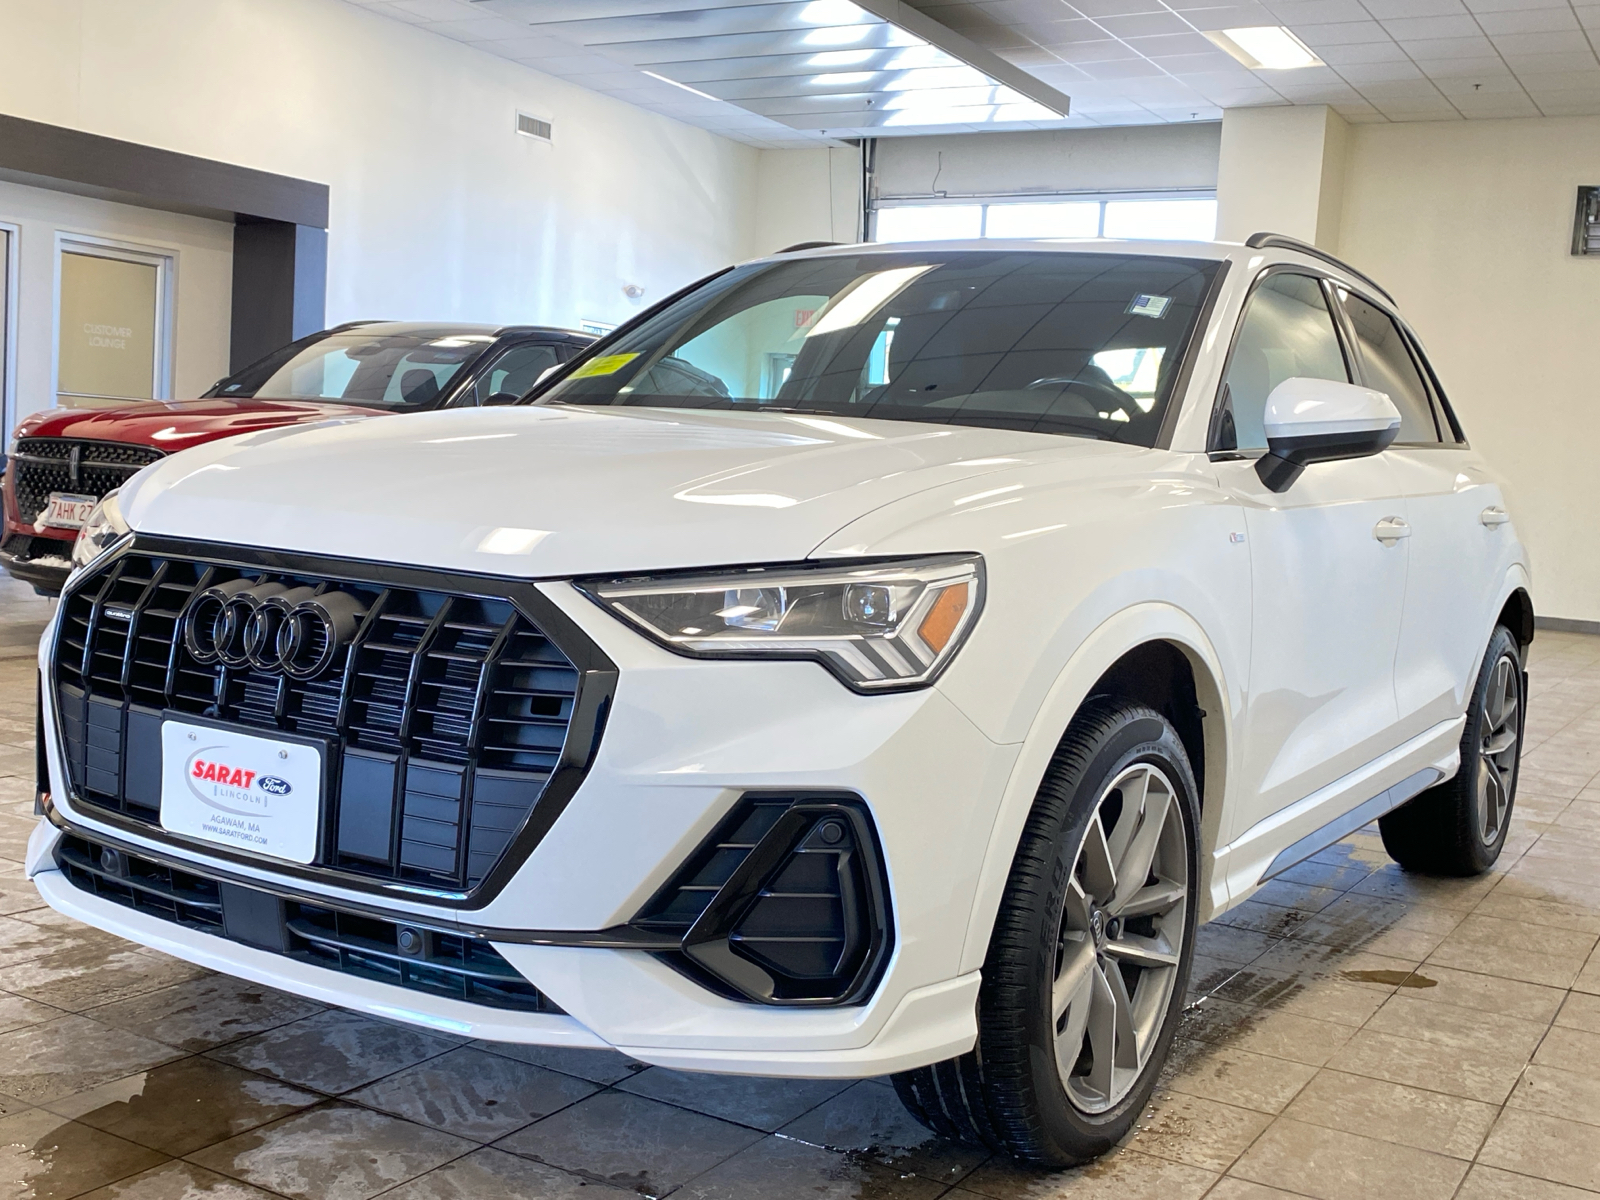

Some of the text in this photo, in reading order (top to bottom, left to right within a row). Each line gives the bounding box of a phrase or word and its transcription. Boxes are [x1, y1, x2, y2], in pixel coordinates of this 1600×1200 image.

[84, 323, 132, 338] CUSTOMER
[89, 336, 126, 350] LOUNGE
[50, 501, 77, 521] 7AHK
[192, 760, 287, 794] SARAT Ford
[220, 788, 261, 804] LINCOLN
[210, 814, 261, 833] AGAWAM, MA
[202, 823, 268, 845] WWW.SARATFORD.COM
